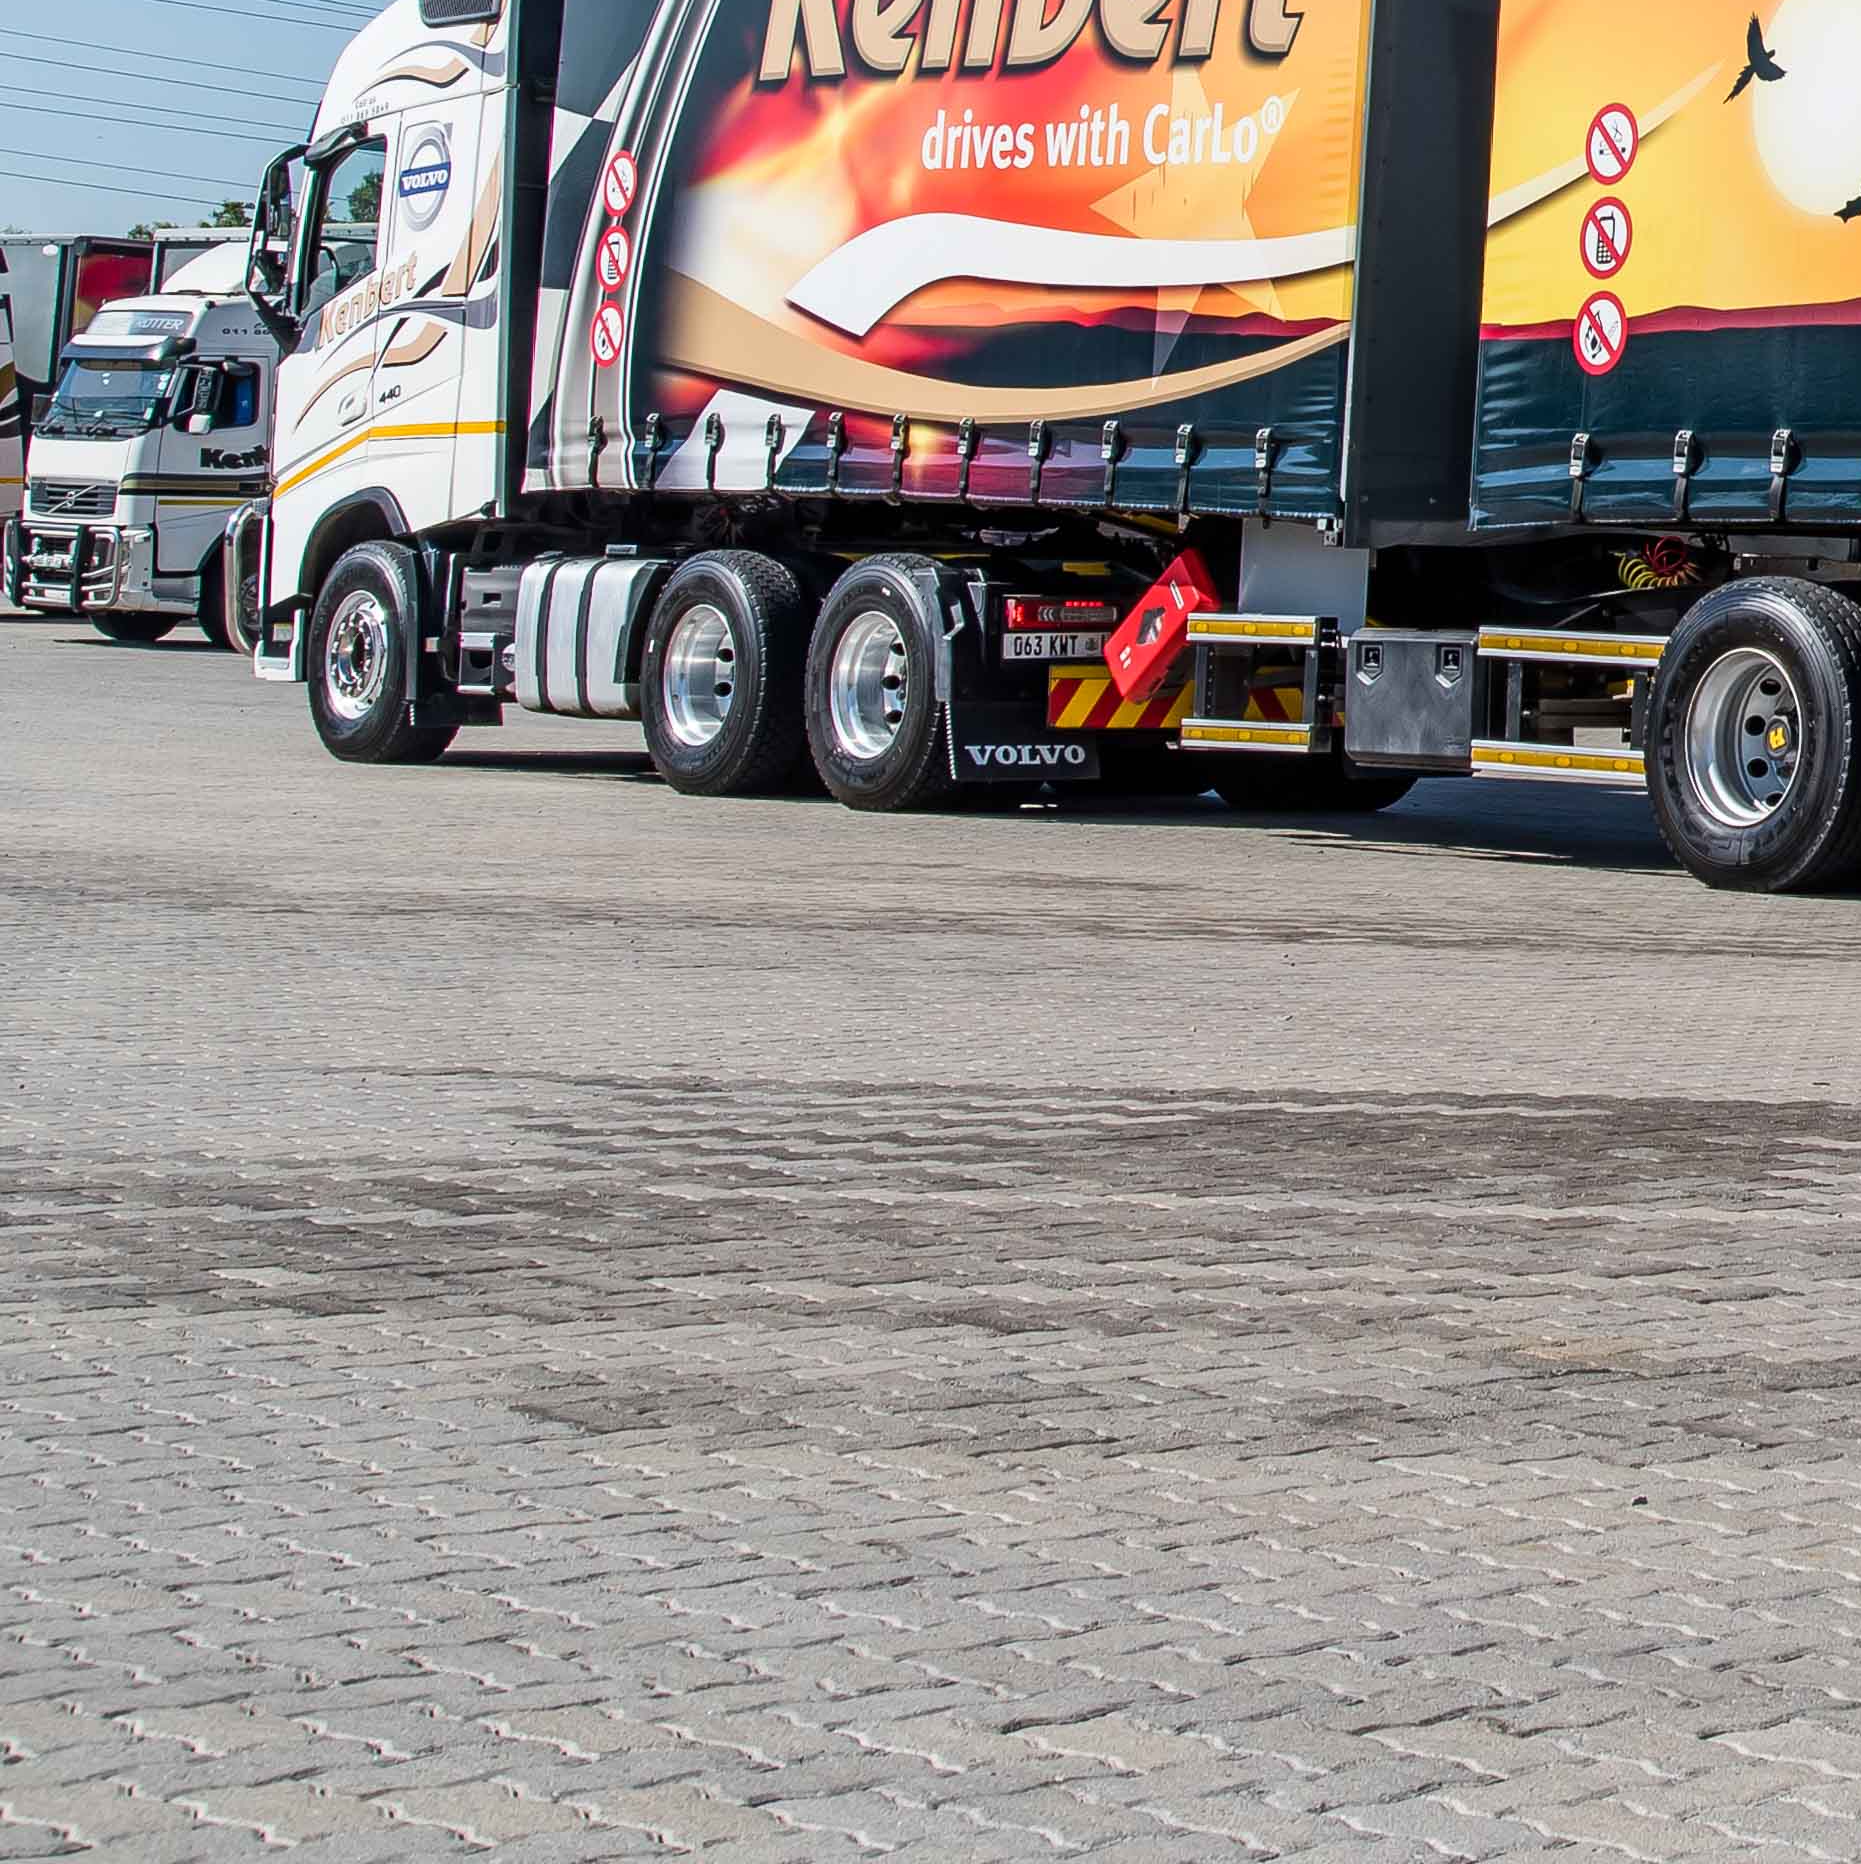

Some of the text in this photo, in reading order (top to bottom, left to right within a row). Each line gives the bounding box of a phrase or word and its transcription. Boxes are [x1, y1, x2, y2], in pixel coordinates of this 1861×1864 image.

[922, 109, 1034, 169] drives
[1046, 104, 1129, 166] with
[402, 169, 449, 191] VOLVO
[318, 250, 418, 350] Kenbert
[379, 385, 402, 404] 440
[1049, 635, 1079, 656] KWT
[964, 744, 1085, 765] VOLVO
